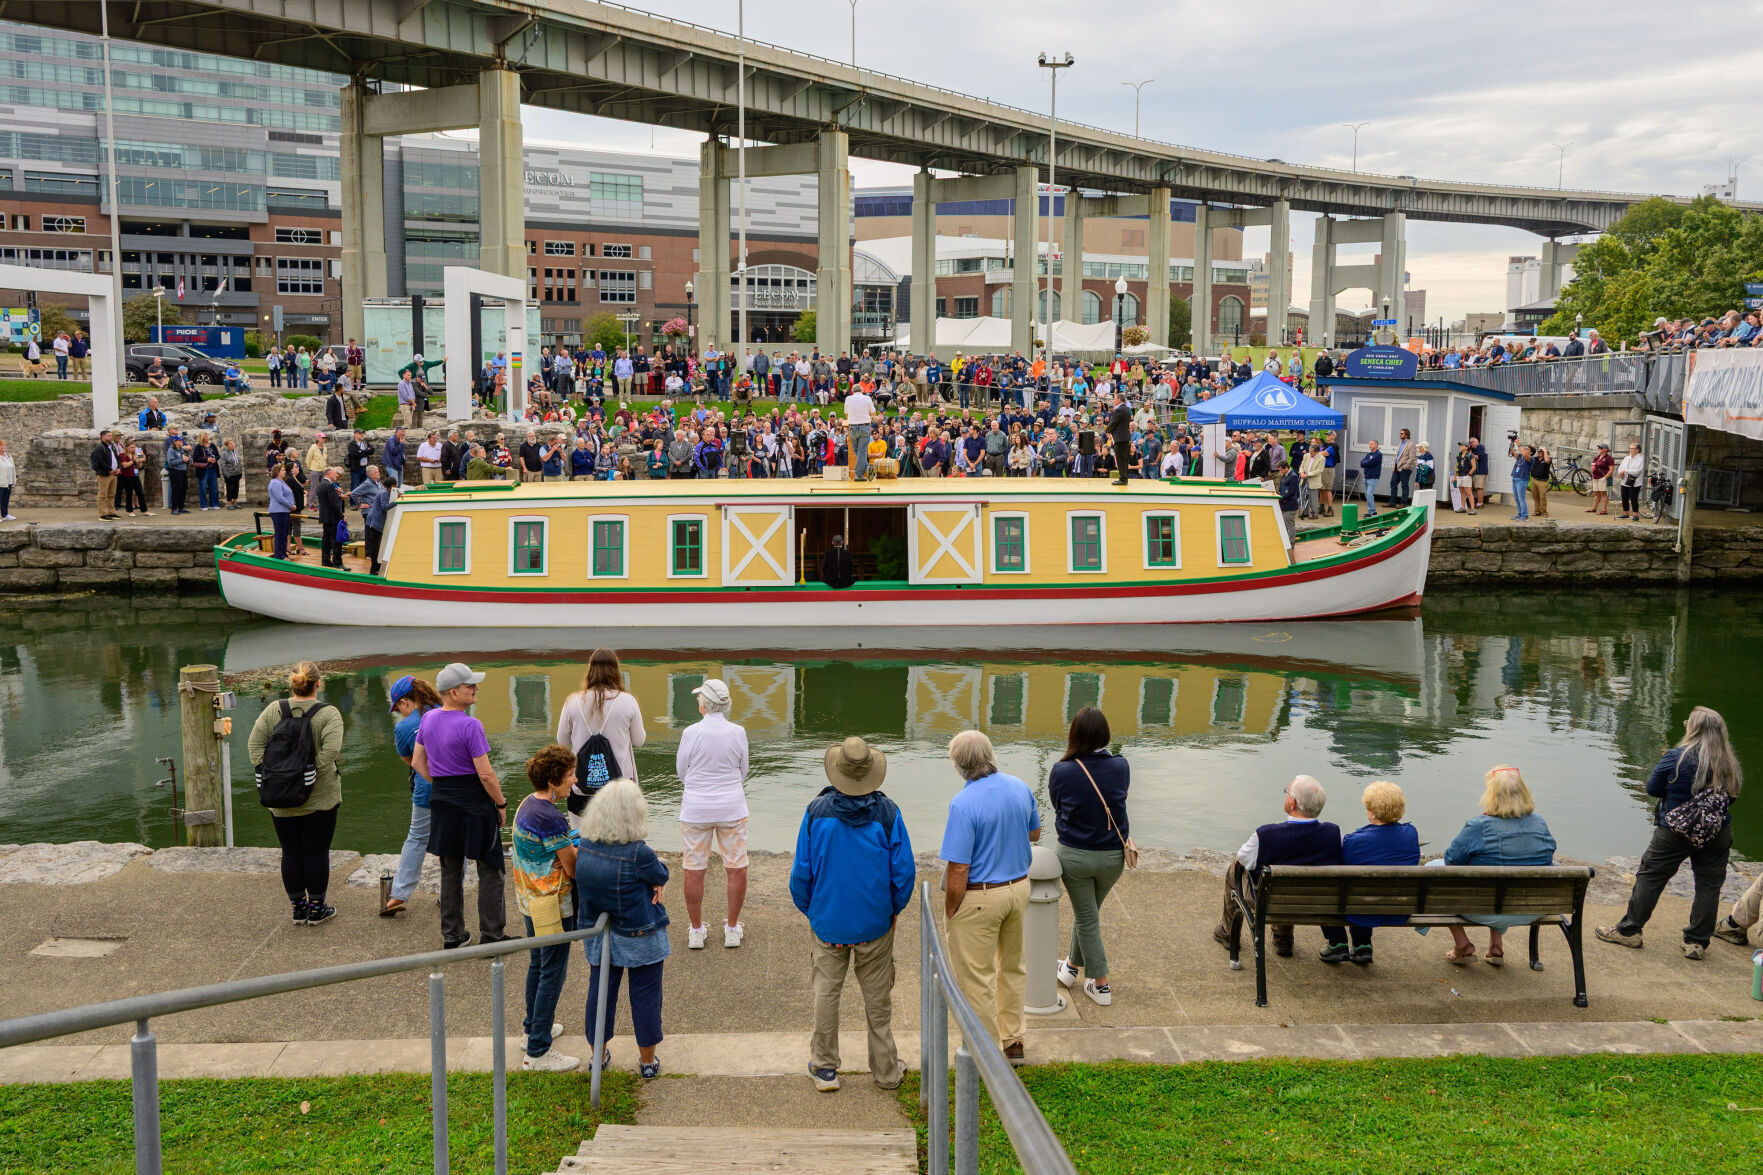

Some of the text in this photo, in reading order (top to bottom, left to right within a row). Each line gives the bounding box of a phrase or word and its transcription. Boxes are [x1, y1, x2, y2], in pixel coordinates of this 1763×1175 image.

[525, 171, 575, 186] ECOM
[754, 288, 800, 300] LECOM
[1306, 419, 1336, 427] CENTER
[213, 697, 220, 706] 4
[588, 767, 609, 777] 2025
